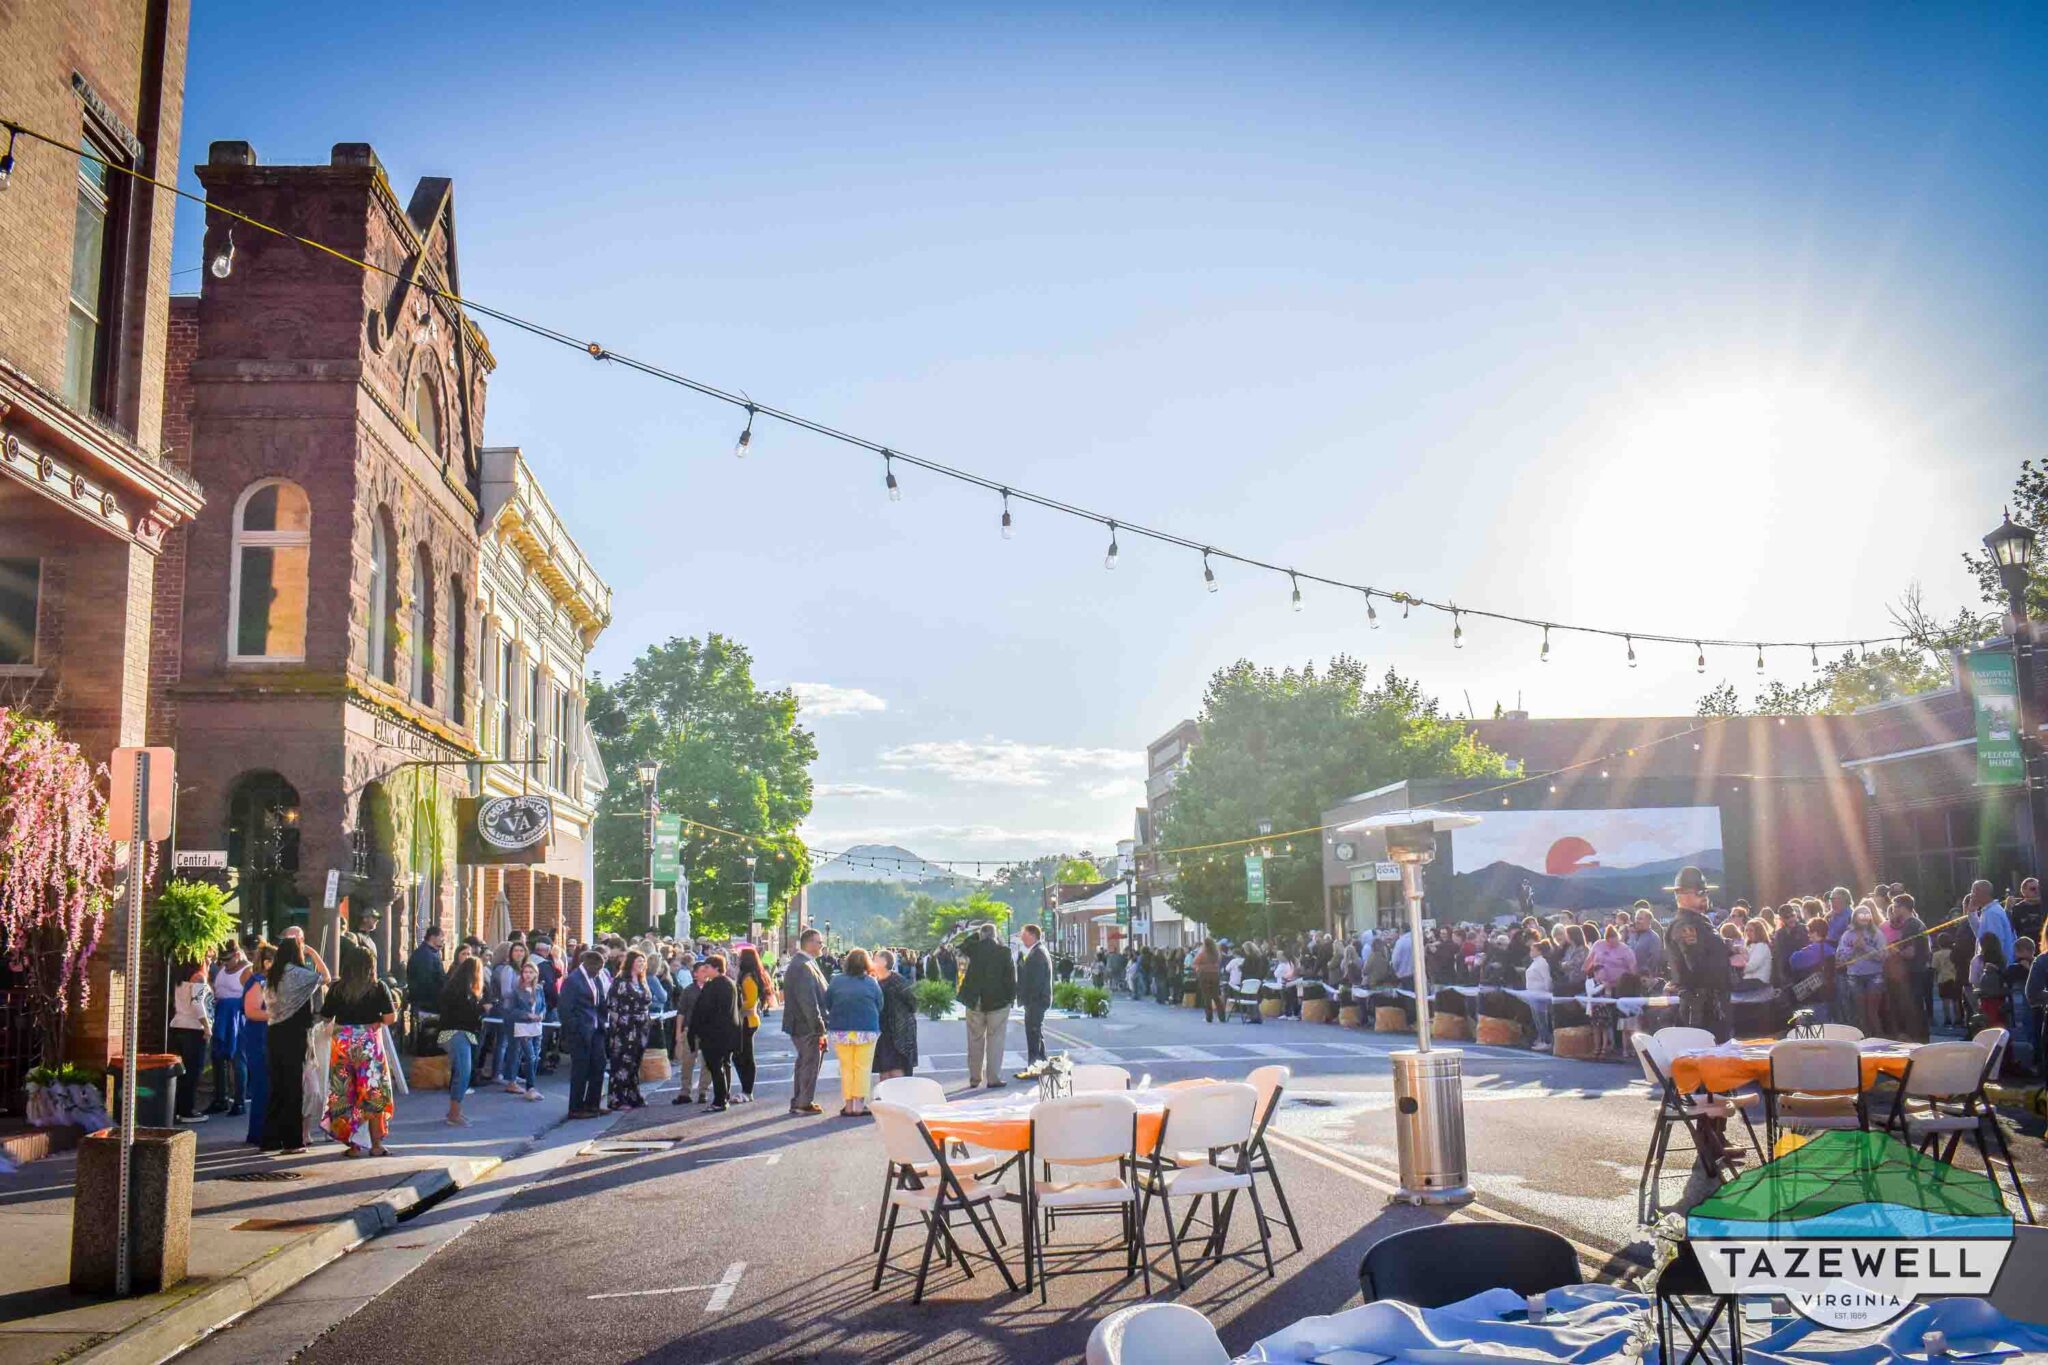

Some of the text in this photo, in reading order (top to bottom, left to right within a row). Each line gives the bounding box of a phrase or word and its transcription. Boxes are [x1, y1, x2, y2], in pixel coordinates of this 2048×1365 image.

[1989, 759, 2014, 767] HOME
[503, 815, 531, 832] VA
[177, 853, 210, 866] Central
